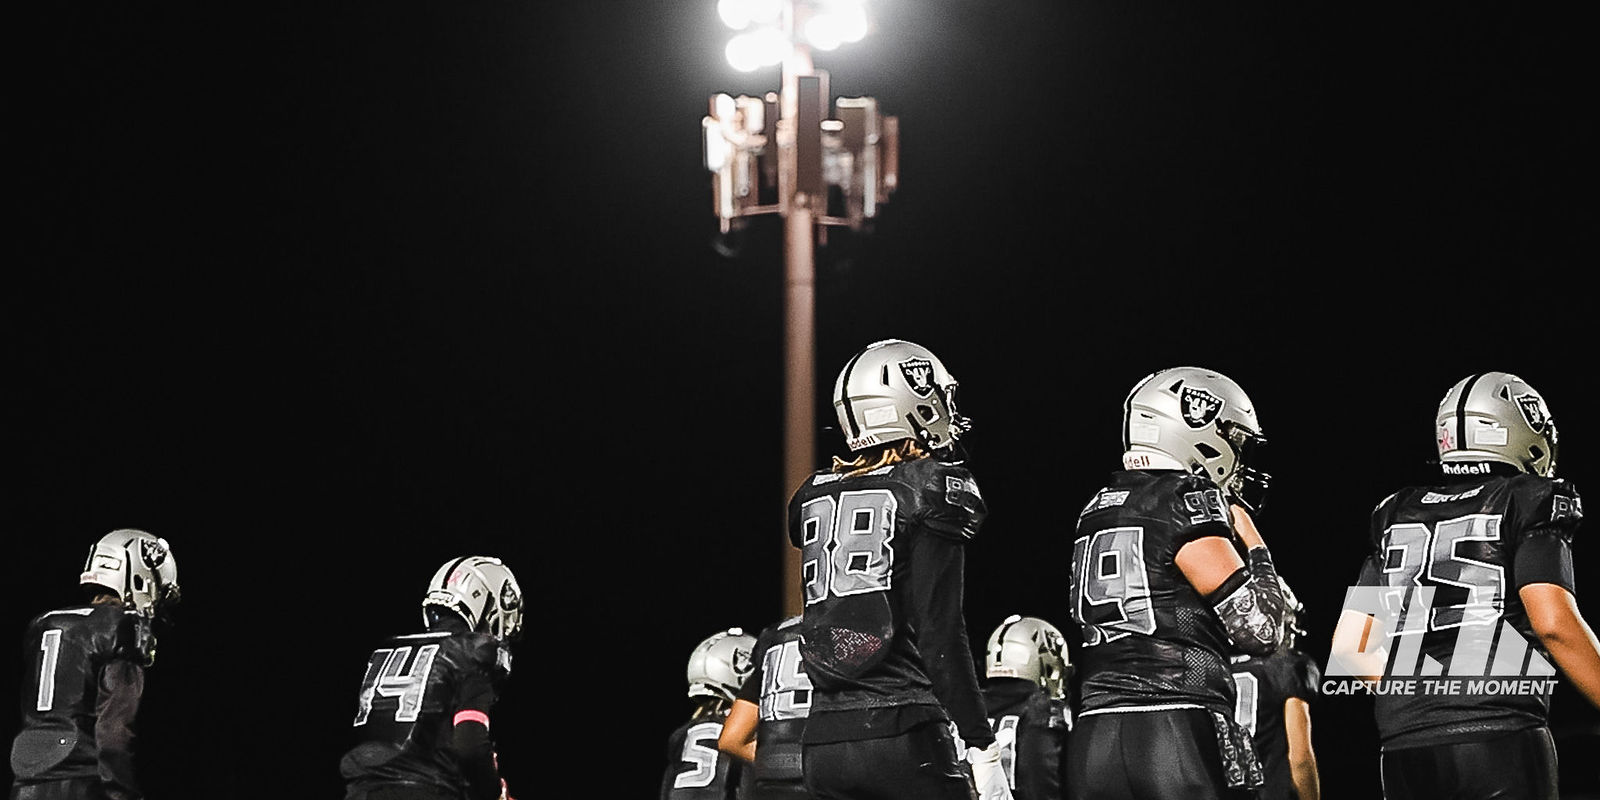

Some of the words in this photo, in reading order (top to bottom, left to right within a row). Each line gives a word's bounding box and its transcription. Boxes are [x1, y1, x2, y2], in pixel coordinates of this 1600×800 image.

[1125, 455, 1150, 469] dell
[1442, 462, 1491, 475] Riddell
[1183, 489, 1228, 525] 99
[801, 488, 898, 607] 88
[1380, 513, 1506, 638] 85
[37, 628, 62, 711] 1
[674, 722, 724, 789] 5
